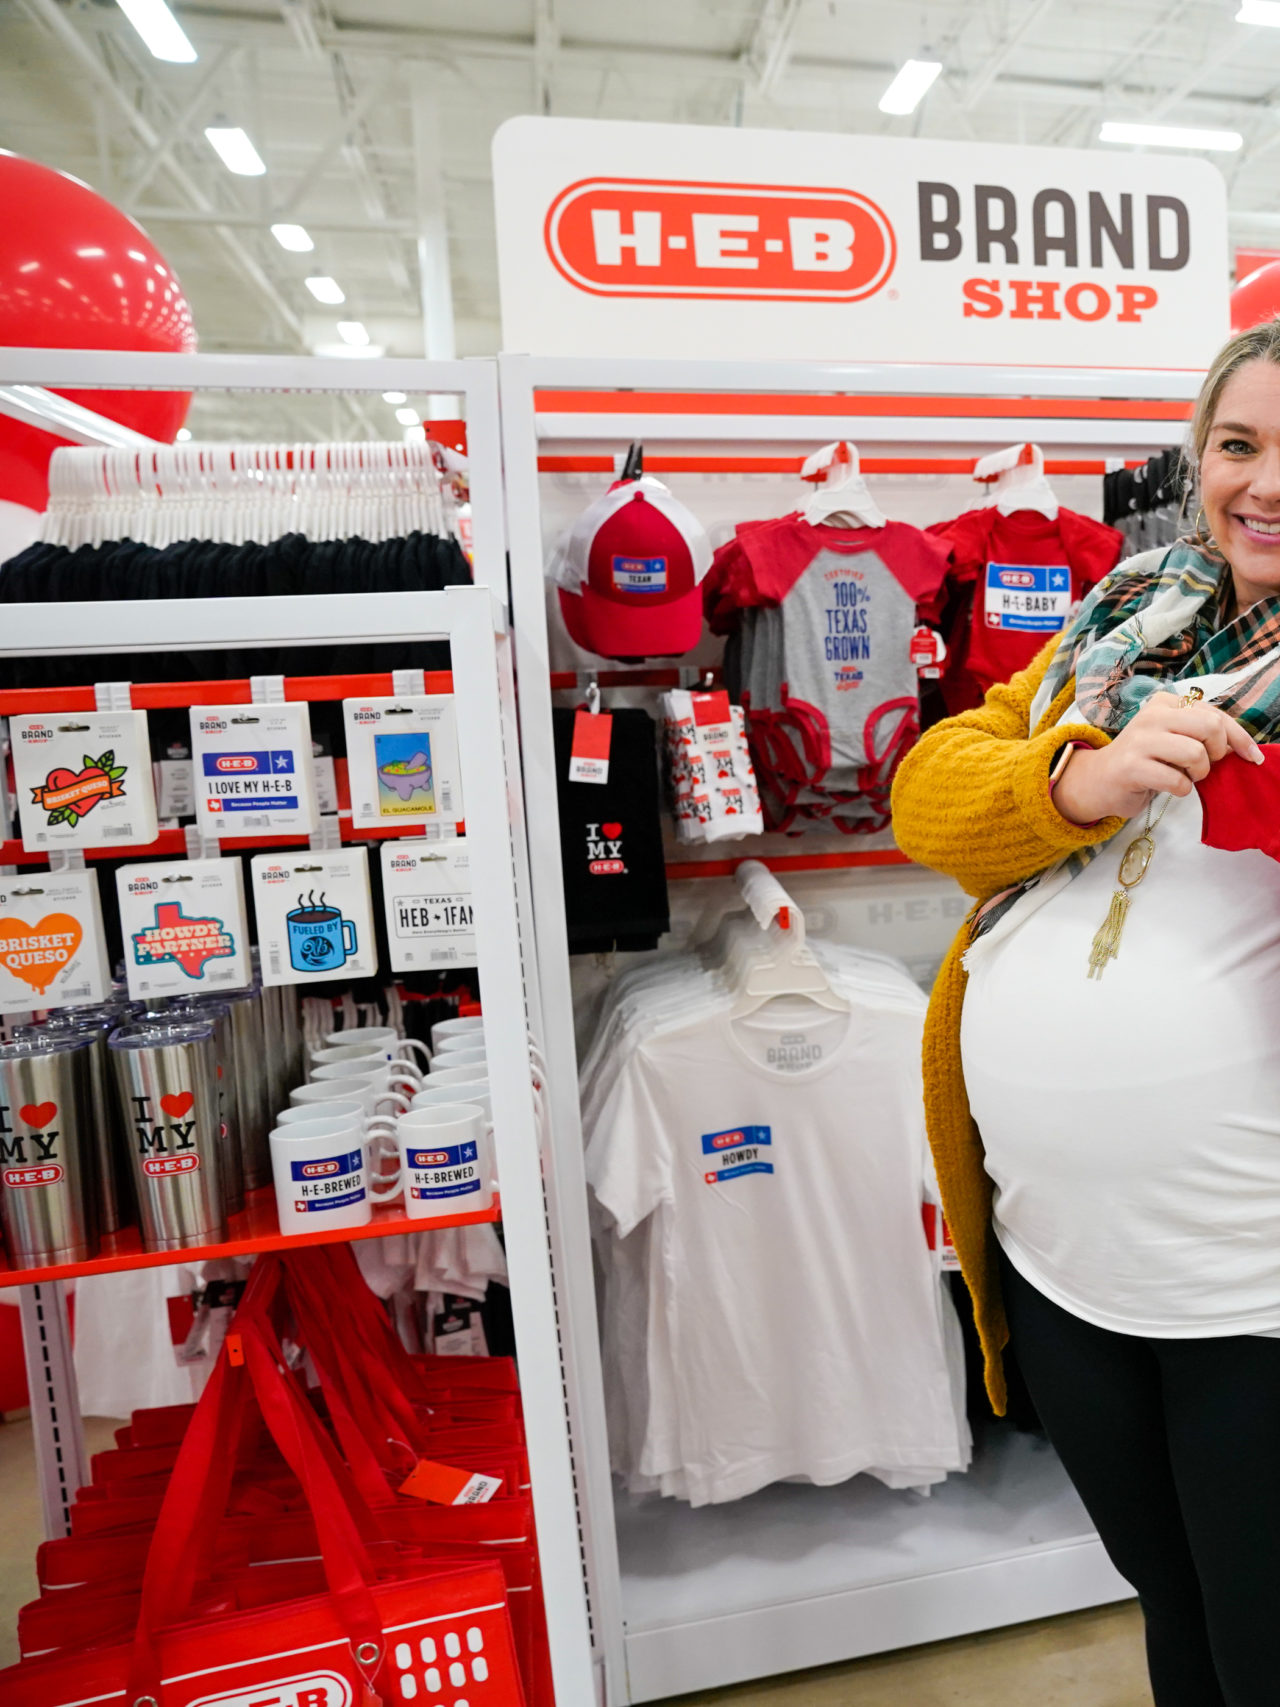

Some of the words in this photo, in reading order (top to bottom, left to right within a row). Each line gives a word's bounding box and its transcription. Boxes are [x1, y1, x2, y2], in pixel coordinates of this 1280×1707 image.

[591, 208, 855, 273] H-E-B
[918, 181, 1191, 271] BRAND
[962, 277, 1159, 323] SHOP
[833, 582, 871, 608] 100%
[825, 609, 867, 634] TEXAS
[824, 635, 870, 661] GROWN
[200, 721, 227, 730] BRAND
[354, 712, 381, 720] BRAND
[22, 730, 53, 739] BRAND
[209, 782, 213, 794] I
[215, 781, 242, 794] LOVE
[244, 780, 259, 793] MY
[263, 780, 292, 792] H-E-B
[392, 805, 433, 813] GUACAMOLE
[586, 823, 600, 841] I
[587, 841, 623, 860] MY
[391, 860, 416, 868] BRAND
[261, 871, 290, 880] BRAND
[128, 882, 158, 892] BRAND
[400, 908, 429, 928] HEB
[145, 923, 220, 942] HOWDY
[293, 925, 324, 935] FUELED
[327, 921, 338, 932] BY
[0, 932, 75, 953] BRISKET
[137, 935, 232, 955] PARTNER
[6, 949, 68, 969] QUESO
[767, 1045, 822, 1063] BRAND
[131, 1096, 154, 1123] I
[136, 1120, 197, 1153] MY
[0, 1131, 59, 1164] MY
[722, 1147, 759, 1166] HOWDY
[148, 1157, 195, 1173] H-E-B
[8, 1169, 56, 1184] H-E-B
[415, 1166, 474, 1184] H-E-BREWED
[302, 1175, 361, 1196] H-E-BREWED
